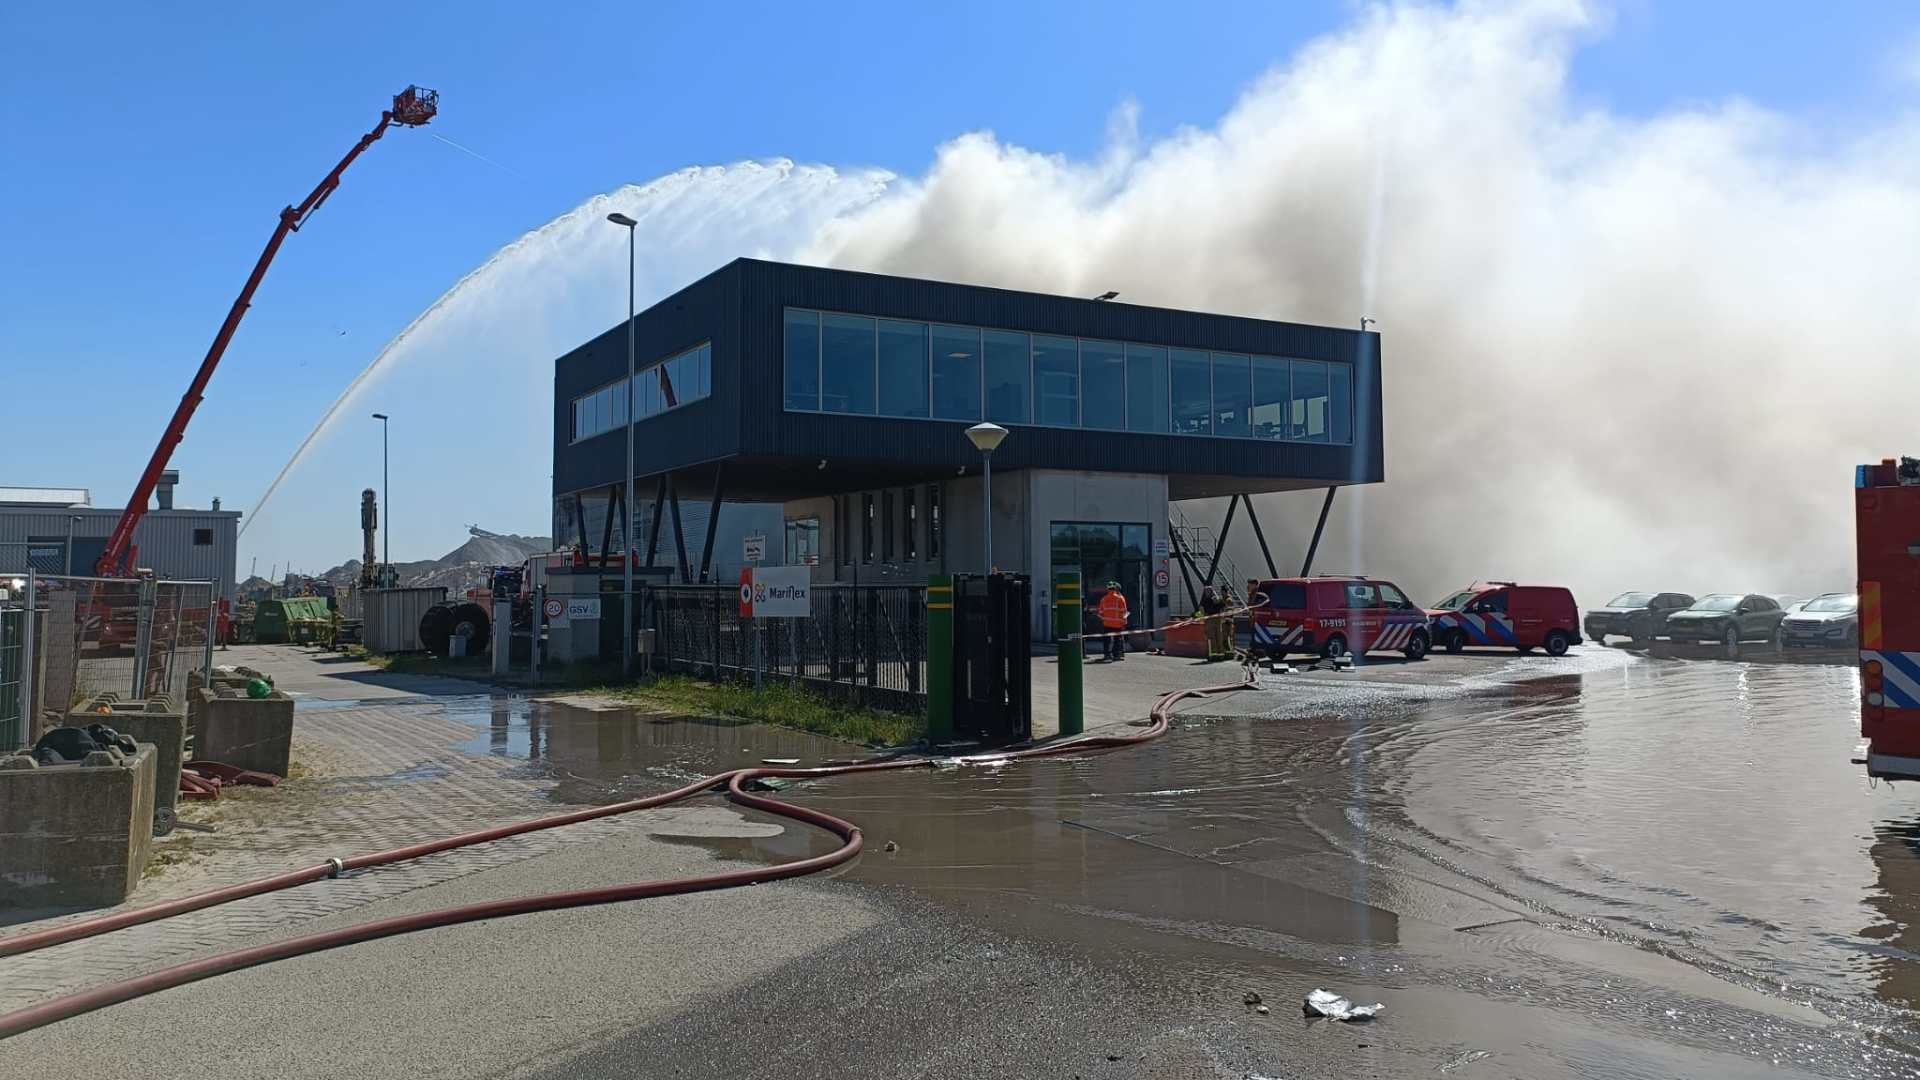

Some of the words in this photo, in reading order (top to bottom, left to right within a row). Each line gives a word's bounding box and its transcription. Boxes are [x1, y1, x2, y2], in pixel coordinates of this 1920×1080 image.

[1158, 574, 1167, 584] 15
[769, 585, 806, 601] Mariflex
[548, 604, 560, 613] 20
[569, 605, 588, 614] GSV
[1319, 618, 1346, 628] 17-9191
